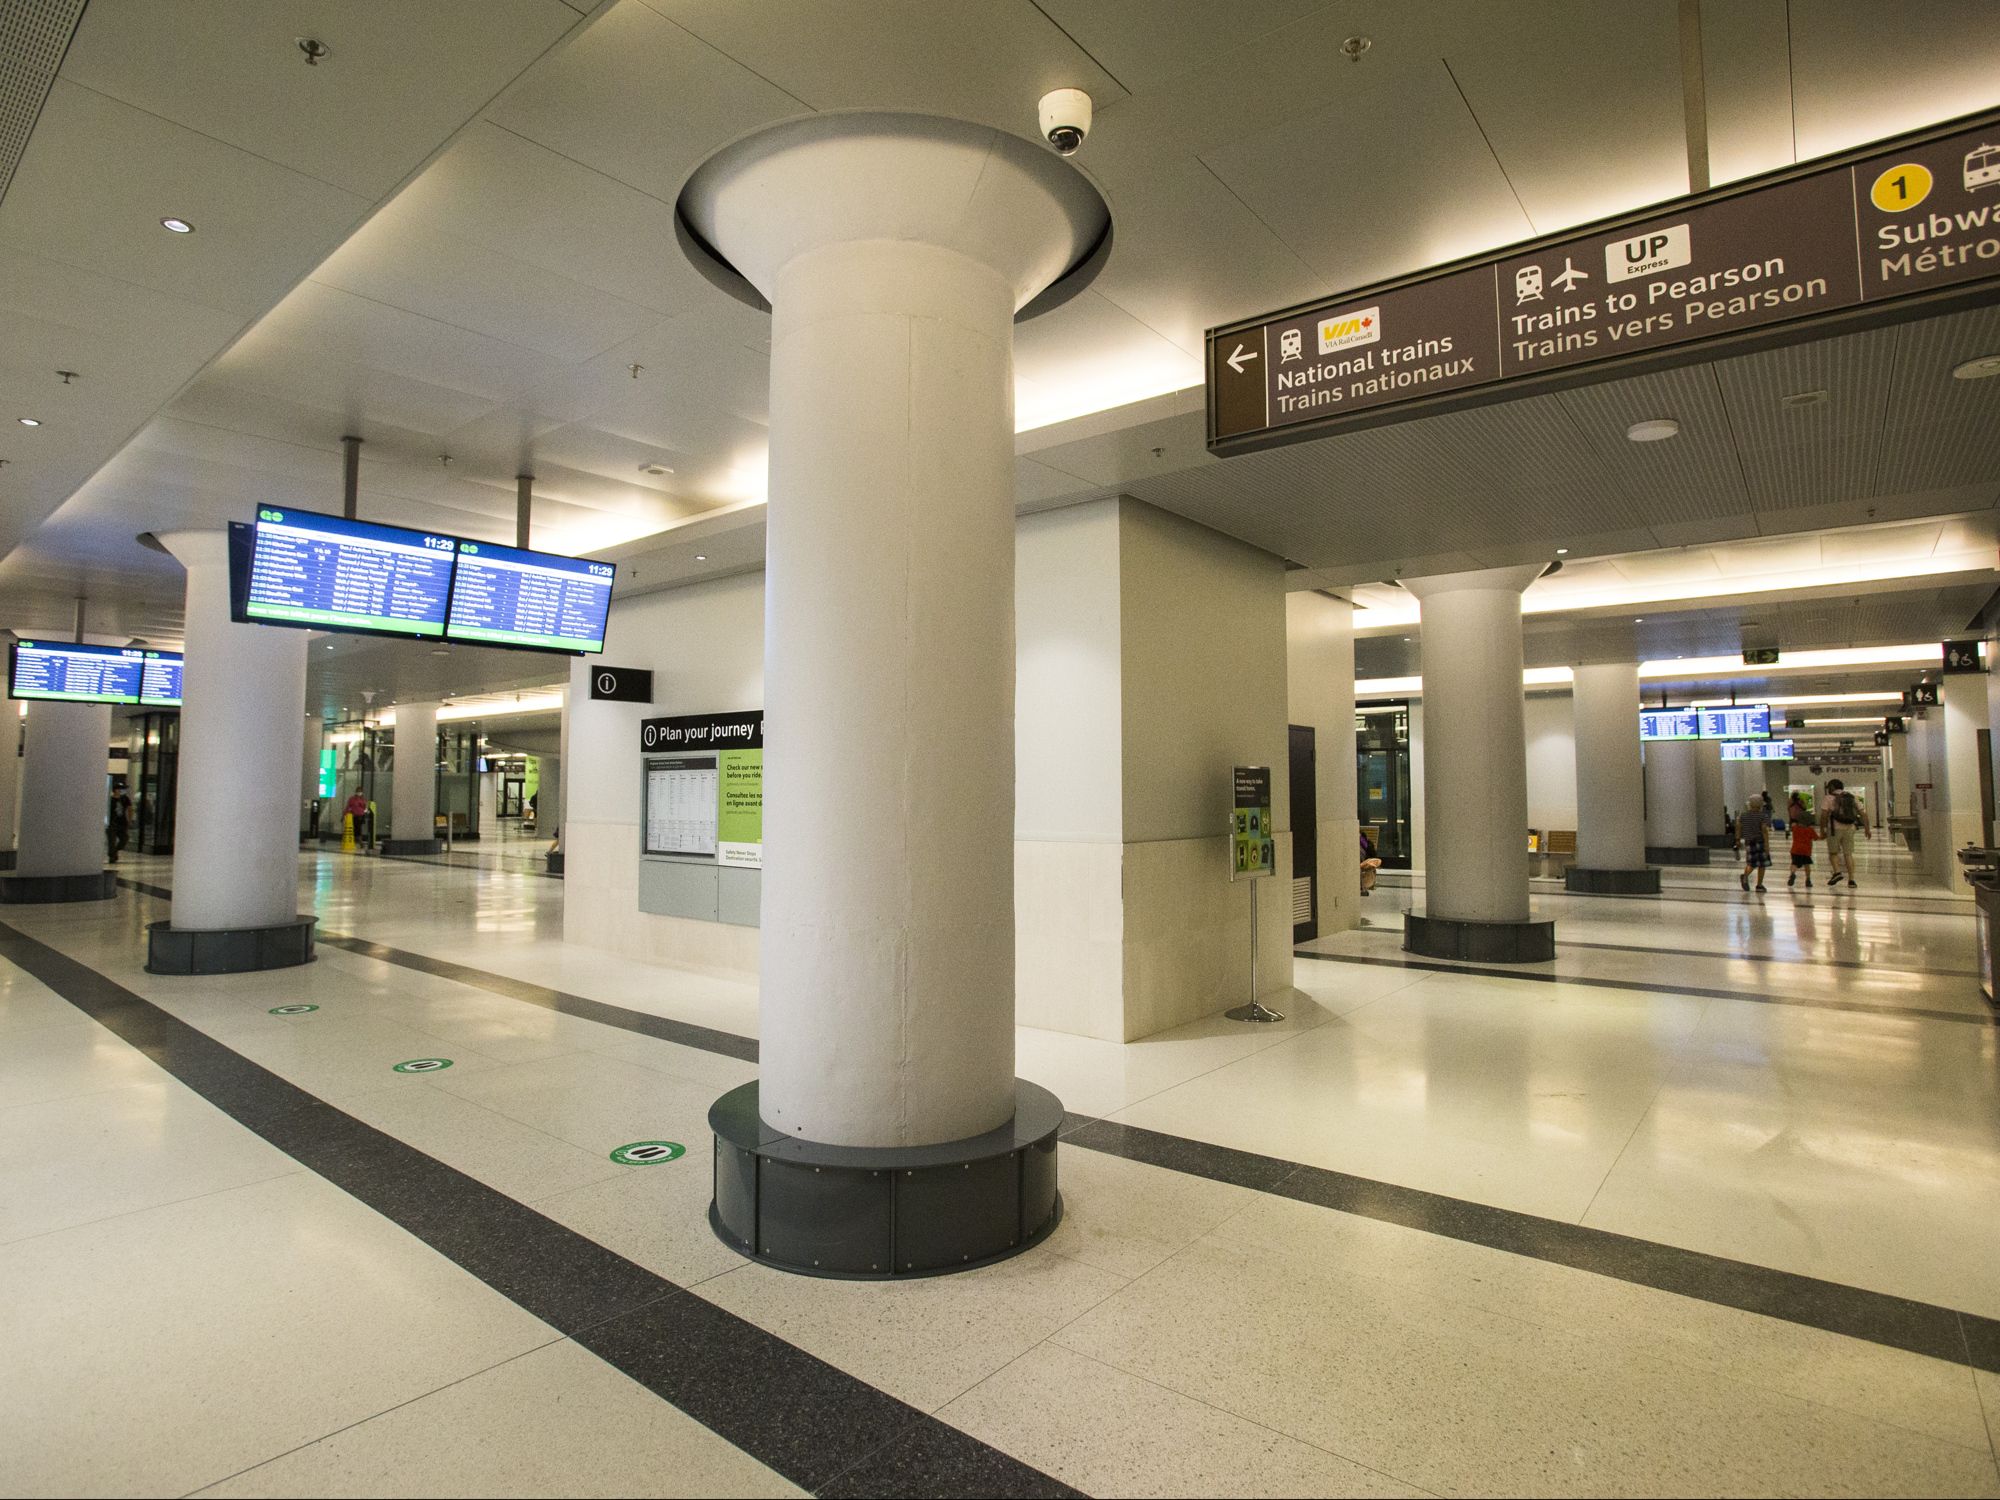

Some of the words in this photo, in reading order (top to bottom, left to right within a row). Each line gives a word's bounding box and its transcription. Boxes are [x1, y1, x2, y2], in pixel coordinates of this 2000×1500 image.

[1891, 175, 1907, 200] 1
[1625, 235, 1669, 263] UP
[1880, 238, 2000, 281] Métro
[1627, 258, 1669, 274] Express
[1511, 302, 1597, 336] Trains
[1605, 292, 1637, 314] to
[1648, 257, 1785, 305] Pearson
[1324, 318, 1360, 341] VIA
[1512, 329, 1598, 361] Trains
[1608, 312, 1674, 341] vers
[1685, 277, 1827, 325] Pearson
[1325, 340, 1338, 349] VIA
[1338, 336, 1350, 345] Rail
[1350, 331, 1373, 342] Canada
[1277, 351, 1375, 391] National
[1380, 336, 1453, 366] trains
[1277, 386, 1343, 413] Trains
[1350, 357, 1475, 398] nationaux
[423, 536, 455, 551] 11:29
[588, 564, 613, 576] 11:29
[660, 726, 682, 741] Plan
[684, 727, 709, 744] your
[709, 723, 755, 743] journey
[726, 791, 749, 799] Consultez
[733, 799, 744, 808] ligne
